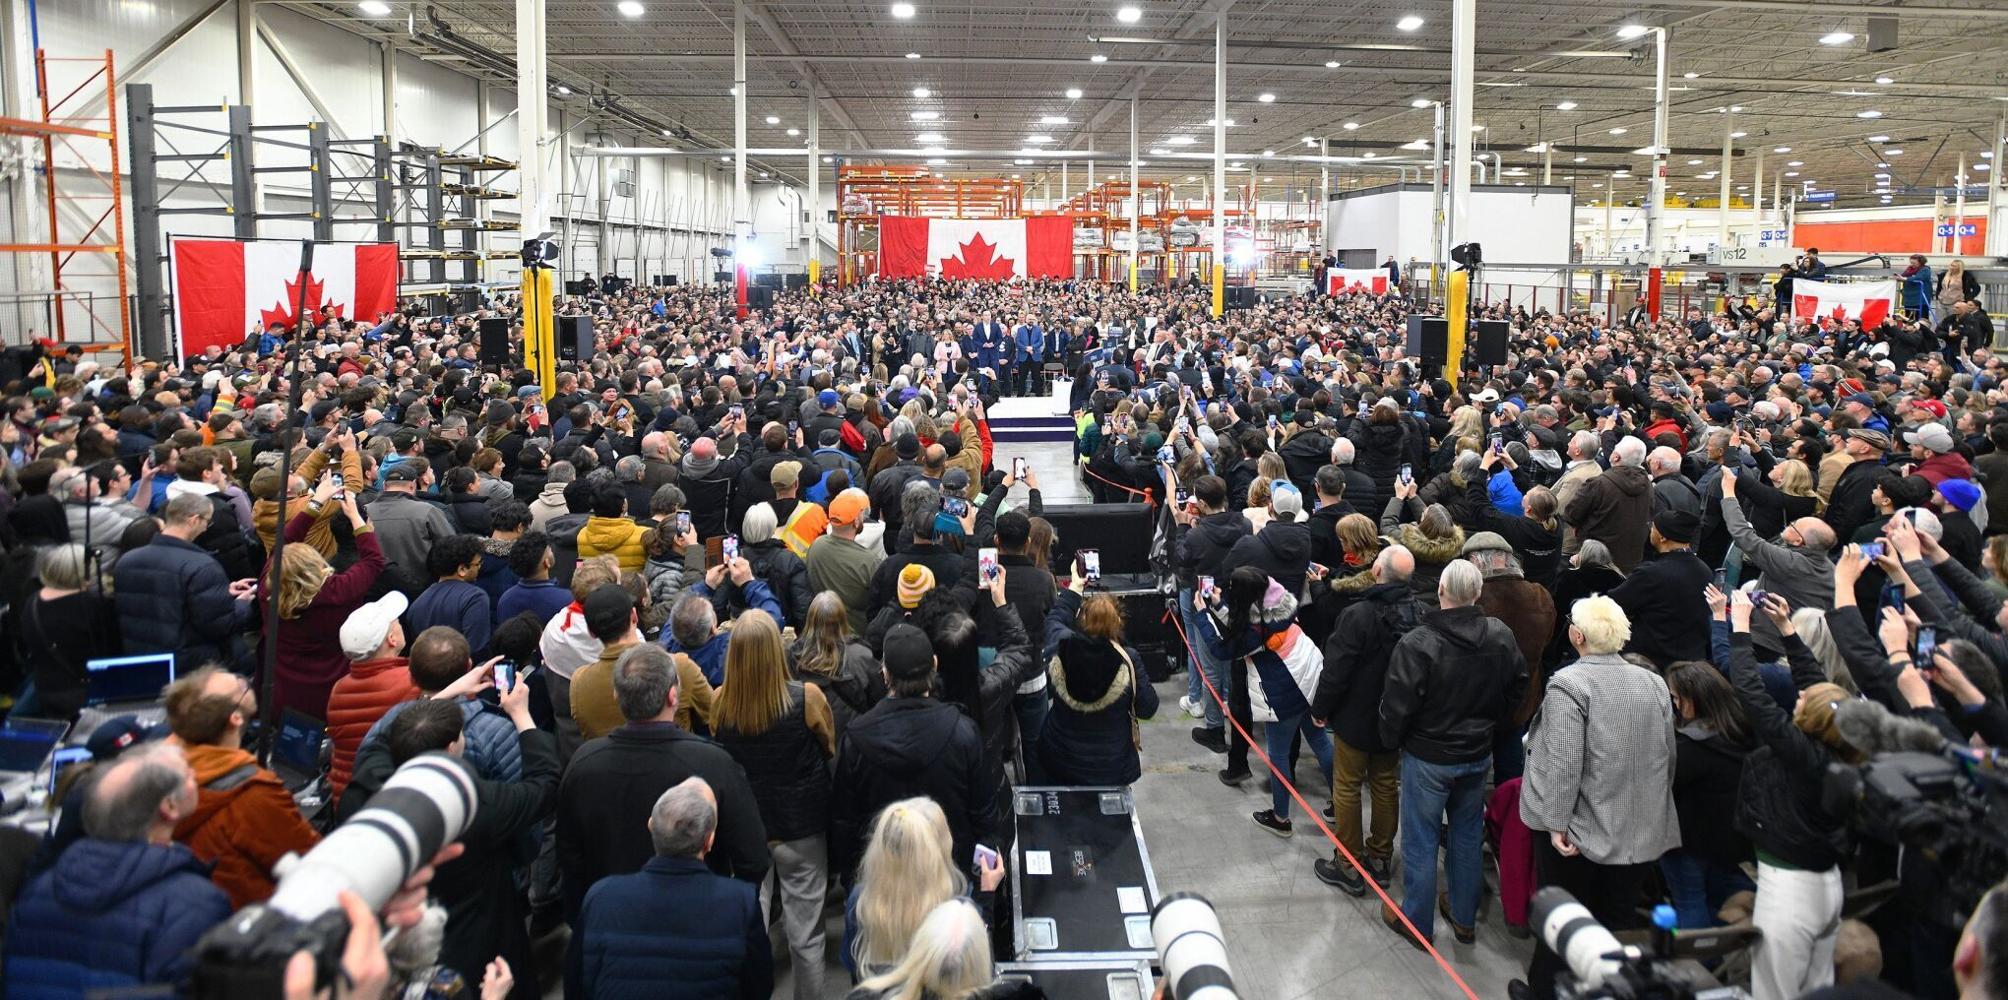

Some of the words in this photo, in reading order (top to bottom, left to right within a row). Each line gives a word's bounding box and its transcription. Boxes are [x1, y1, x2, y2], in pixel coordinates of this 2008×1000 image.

[1938, 226, 1954, 235] Q-5
[1959, 225, 1976, 235] Q-4
[1723, 247, 1747, 260] VS12
